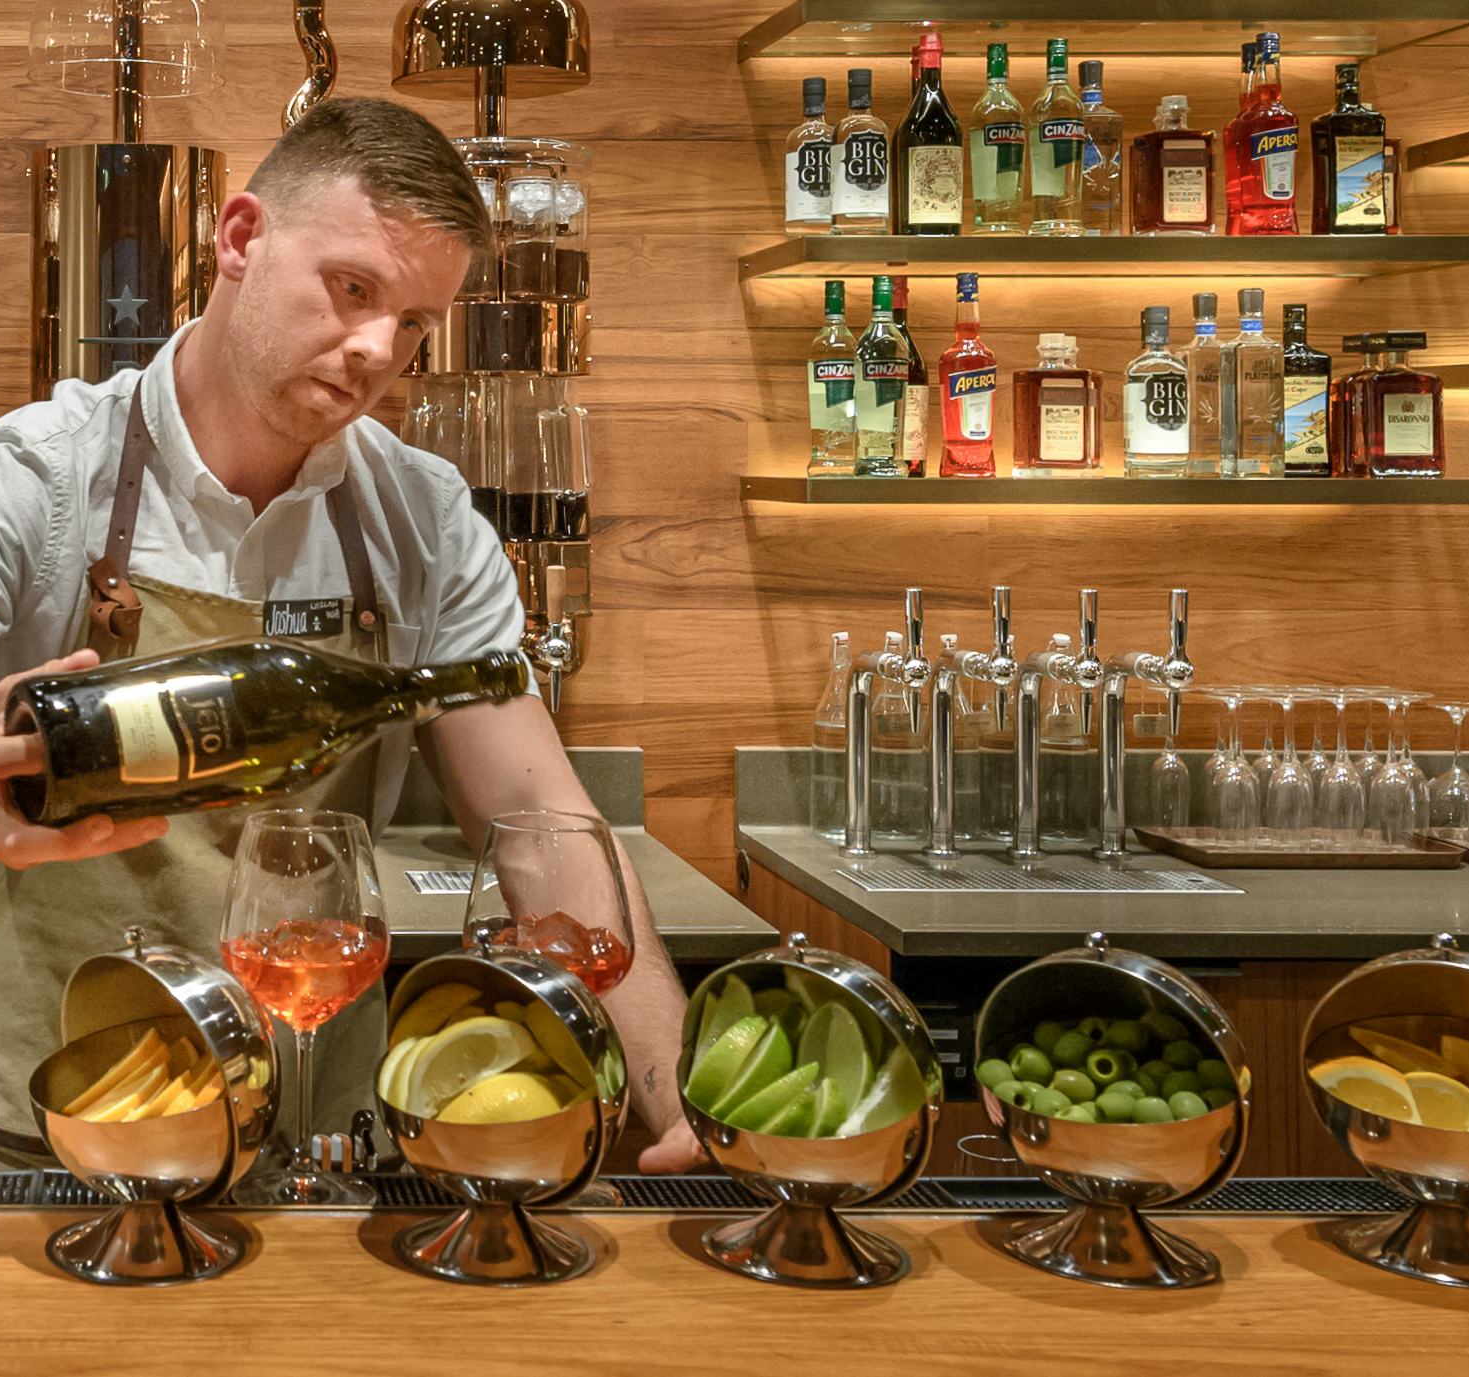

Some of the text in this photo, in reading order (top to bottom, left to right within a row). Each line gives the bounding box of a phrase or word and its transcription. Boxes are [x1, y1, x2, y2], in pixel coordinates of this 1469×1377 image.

[852, 142, 885, 159] BIG
[848, 159, 887, 176] GIN
[1153, 382, 1186, 399] BIG
[1149, 399, 1187, 417] GIN
[265, 603, 308, 637] Joshua
